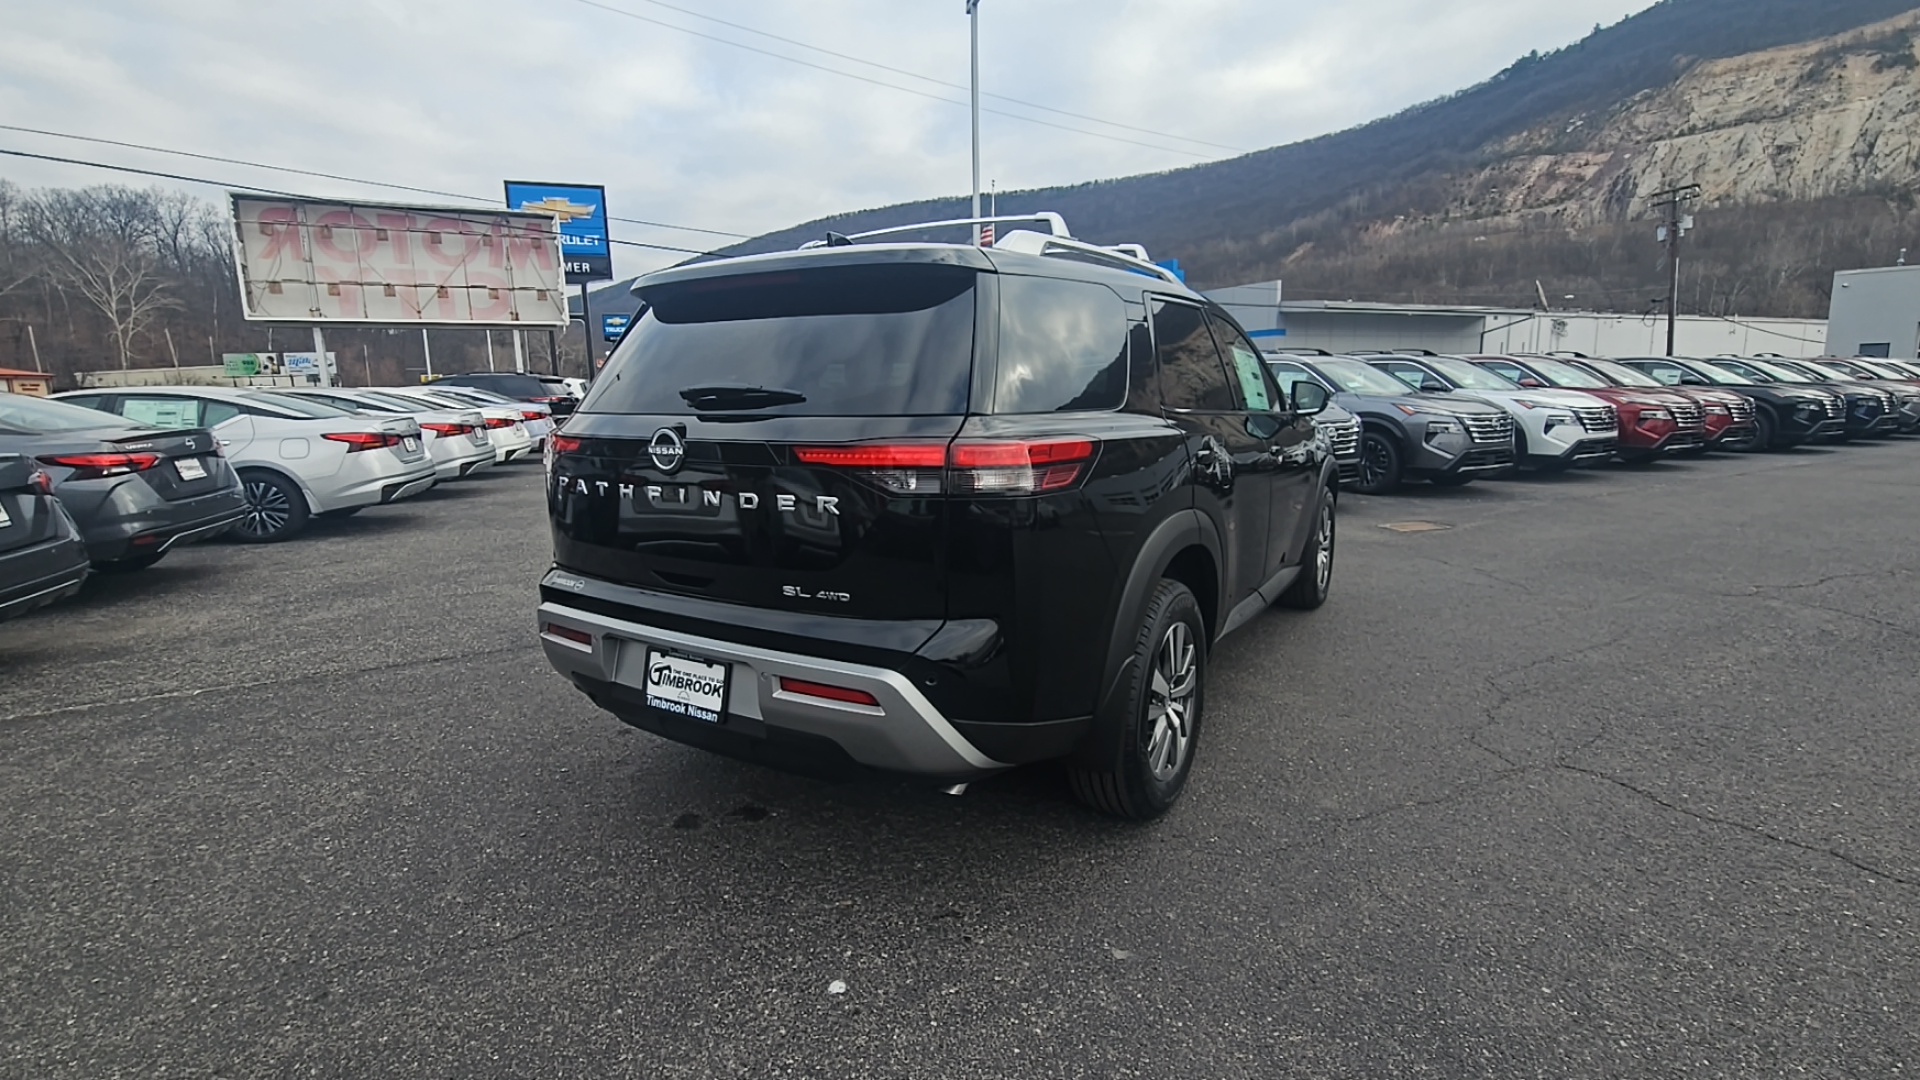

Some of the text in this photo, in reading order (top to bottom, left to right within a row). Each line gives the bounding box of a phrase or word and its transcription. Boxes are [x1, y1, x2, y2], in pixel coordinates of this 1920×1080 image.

[559, 234, 600, 246] ROLET
[563, 262, 590, 273] MER
[648, 446, 684, 455] NISSAN
[558, 475, 840, 516] PATHFINDER
[782, 585, 850, 602] SL 4WD
[650, 662, 724, 698] TIMBROOK
[693, 673, 707, 682] PLACE
[646, 694, 718, 723] Timbrook Nissan
